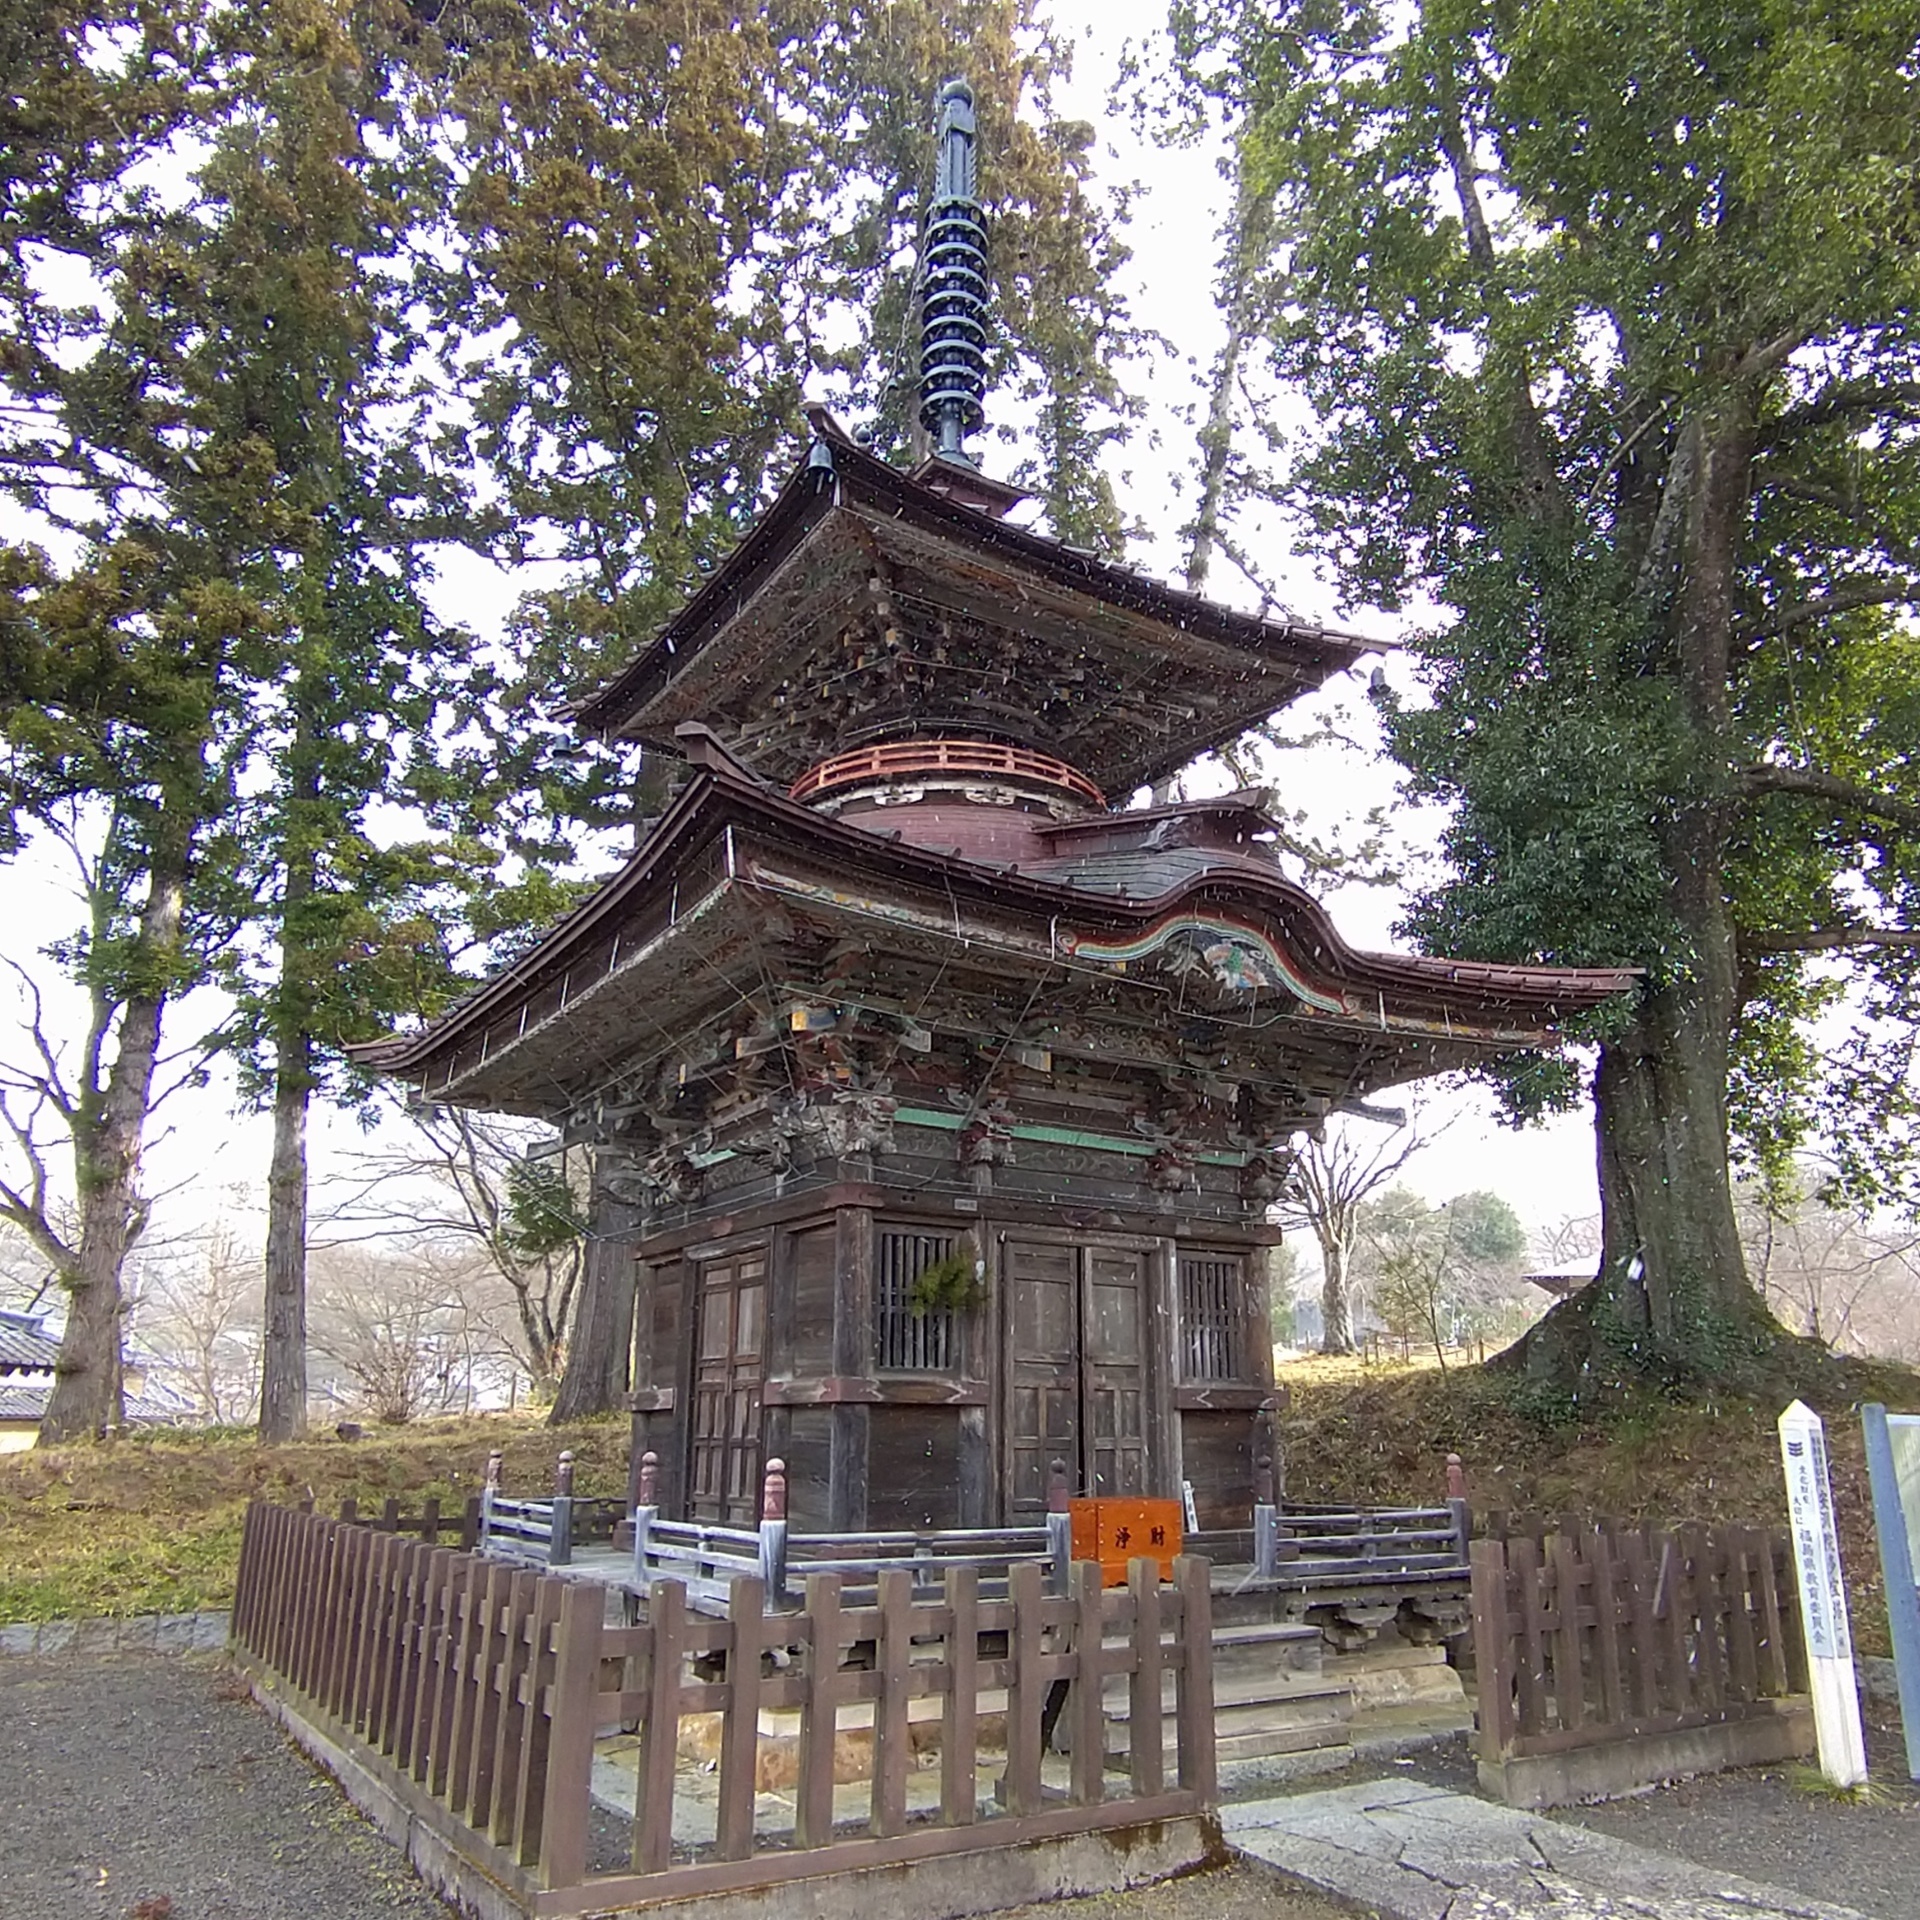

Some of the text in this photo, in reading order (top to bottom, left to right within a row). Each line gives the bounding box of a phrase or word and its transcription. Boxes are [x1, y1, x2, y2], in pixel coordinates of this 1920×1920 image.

[1798, 1465, 1809, 1504] 文化財を
[1793, 1495, 1803, 1525] 大切に
[1799, 1528, 1827, 1643] 福島県教育委員会
